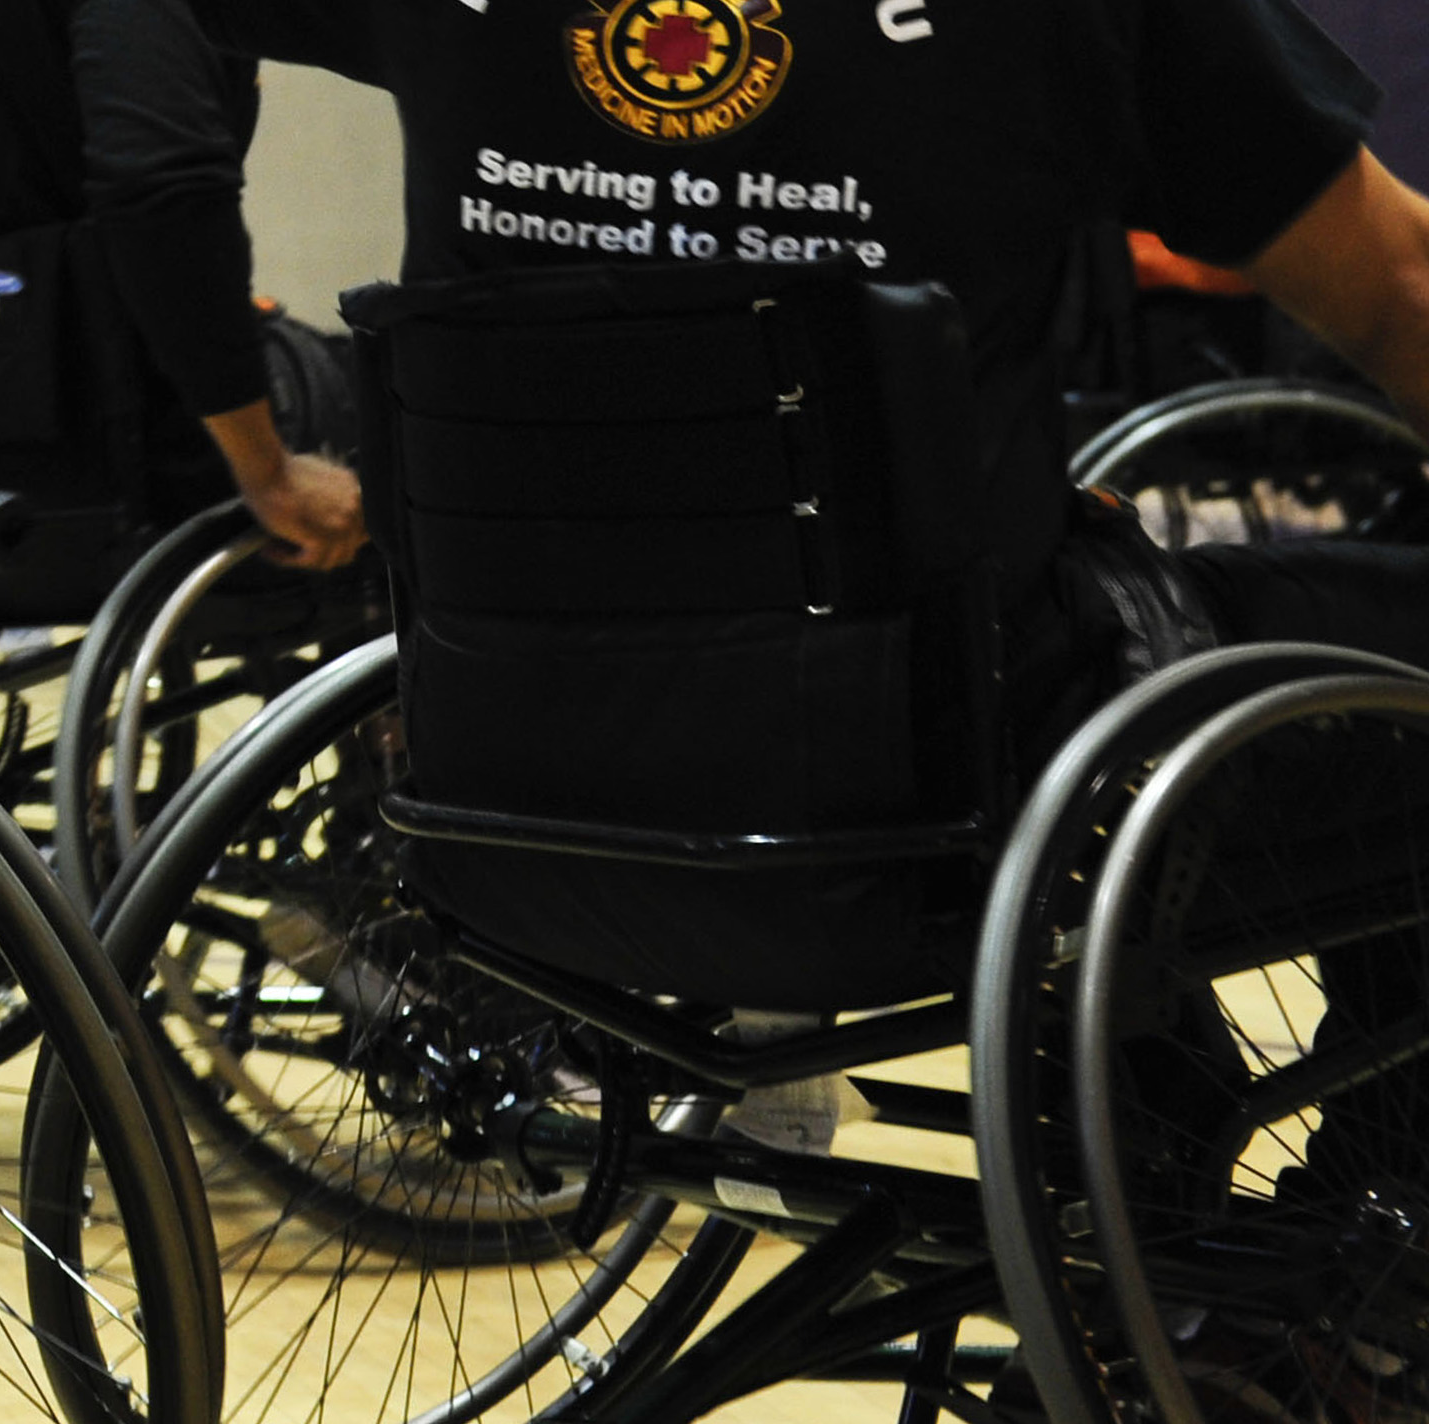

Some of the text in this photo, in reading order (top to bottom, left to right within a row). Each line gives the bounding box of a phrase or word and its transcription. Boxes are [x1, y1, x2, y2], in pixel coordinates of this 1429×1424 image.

[572, 28, 778, 138] MEDICINE IN MOTION
[477, 147, 873, 222] Serving to Heal,
[459, 196, 656, 257] Honored
[668, 223, 719, 260] to
